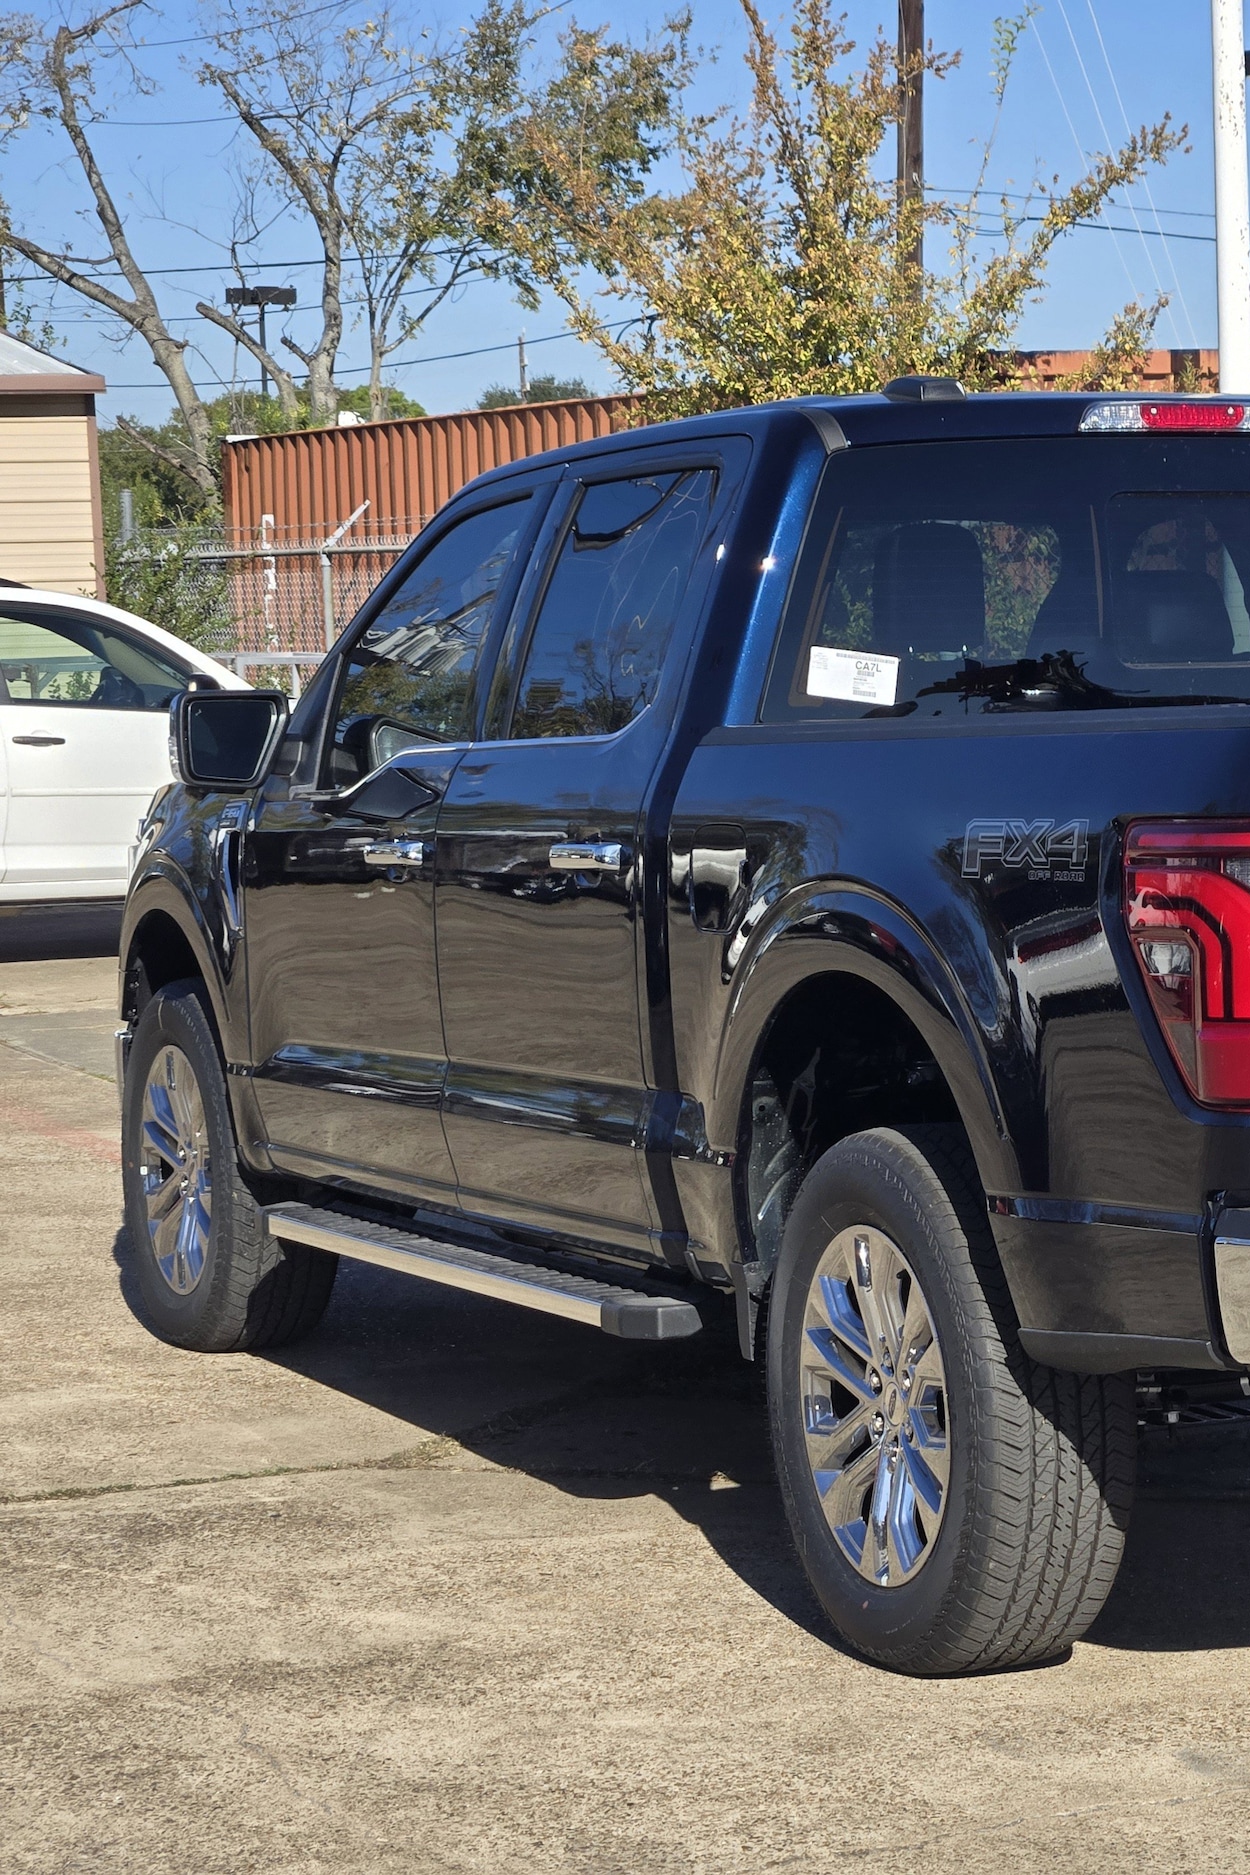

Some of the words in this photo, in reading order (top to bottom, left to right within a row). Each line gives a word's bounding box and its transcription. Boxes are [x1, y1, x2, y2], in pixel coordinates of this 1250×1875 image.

[856, 660, 882, 673] CA7L
[961, 818, 1090, 879] FX4
[1028, 870, 1051, 881] OFF
[1053, 870, 1086, 882] ROAD
